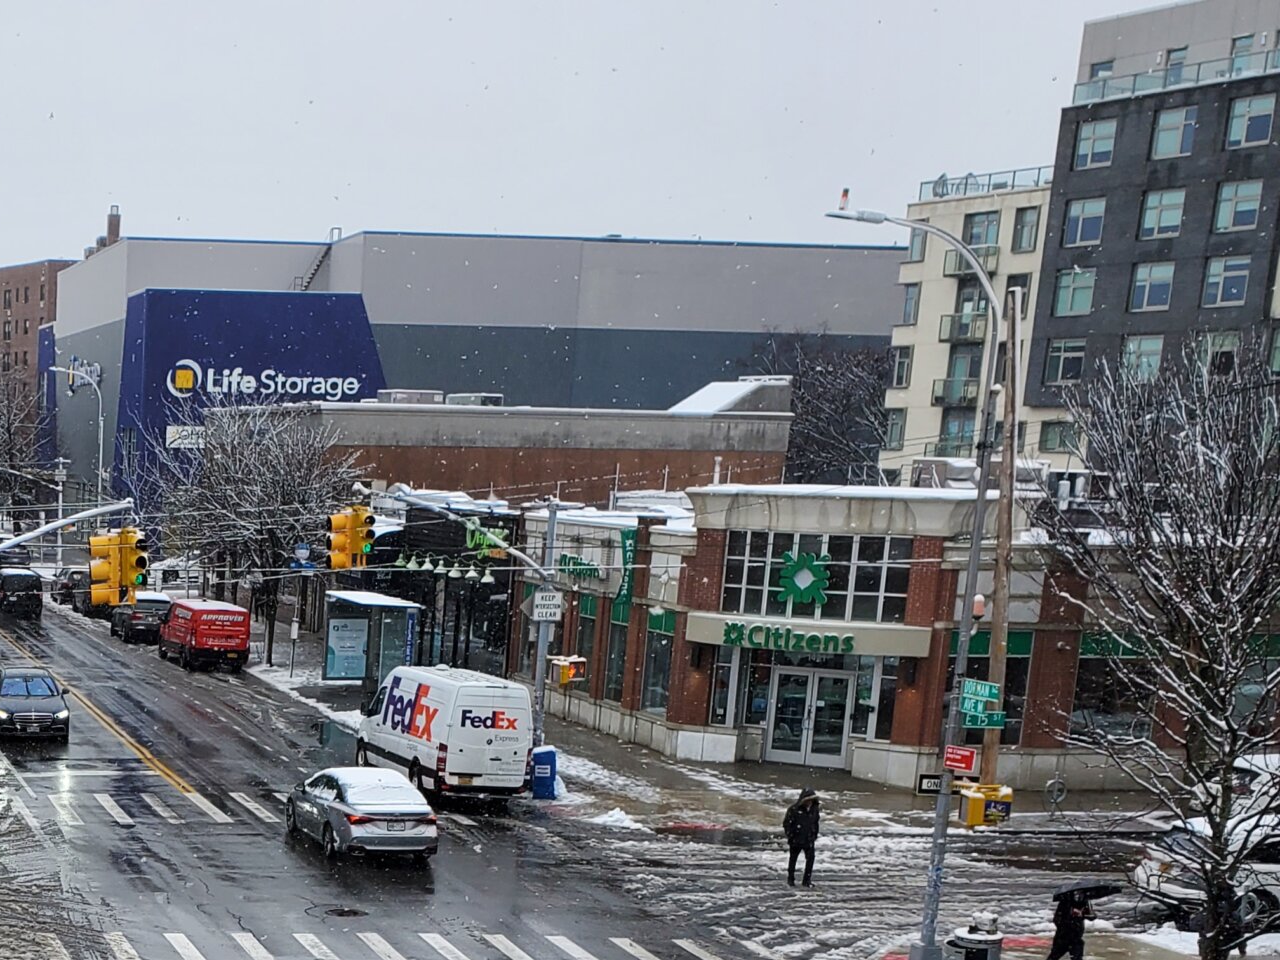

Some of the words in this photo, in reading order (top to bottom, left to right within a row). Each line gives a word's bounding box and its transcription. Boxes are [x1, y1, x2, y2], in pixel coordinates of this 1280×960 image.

[206, 367, 257, 394] Life
[260, 369, 360, 400] Storage
[747, 624, 855, 653] Citizens
[382, 676, 439, 743] FedEx
[963, 697, 977, 712] AVE
[460, 709, 518, 731] FedEx
[977, 714, 989, 726] 15
[494, 734, 520, 743] Express
